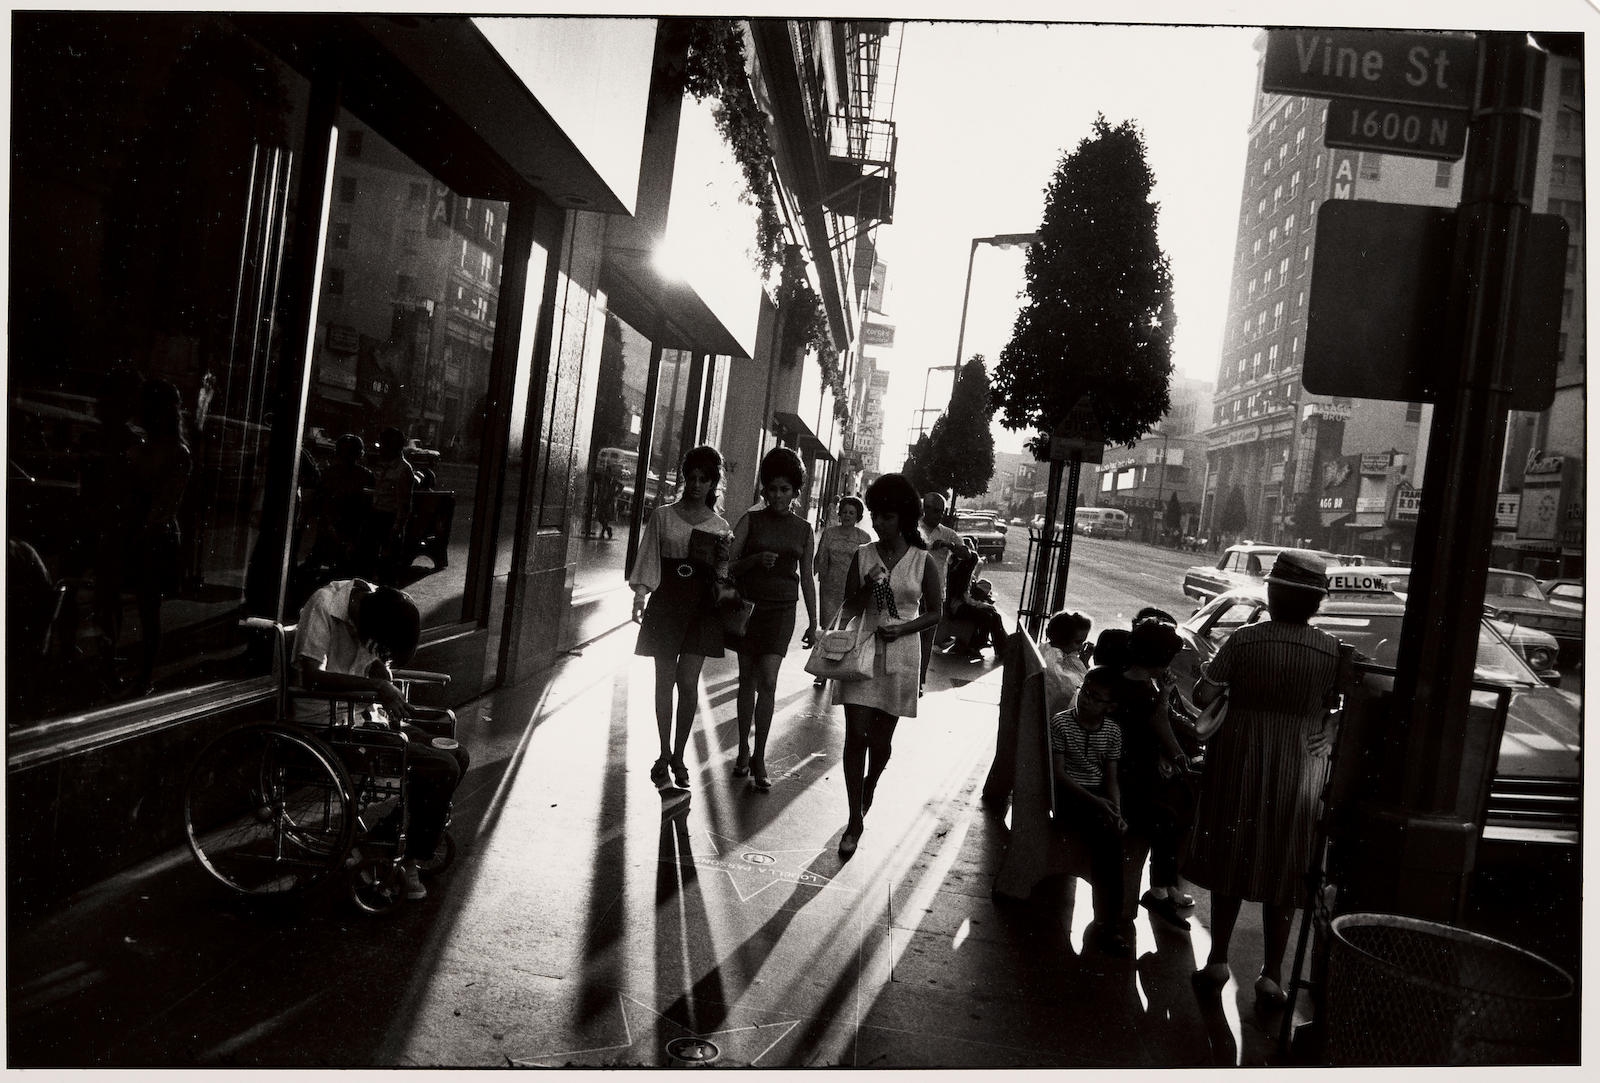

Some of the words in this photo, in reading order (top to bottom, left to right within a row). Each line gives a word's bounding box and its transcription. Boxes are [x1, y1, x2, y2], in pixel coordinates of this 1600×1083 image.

[1295, 35, 1384, 81] Vine
[1405, 46, 1450, 89] St
[1350, 109, 1421, 143] 1600
[1429, 117, 1448, 146] N
[1327, 576, 1382, 589] YELLOW
